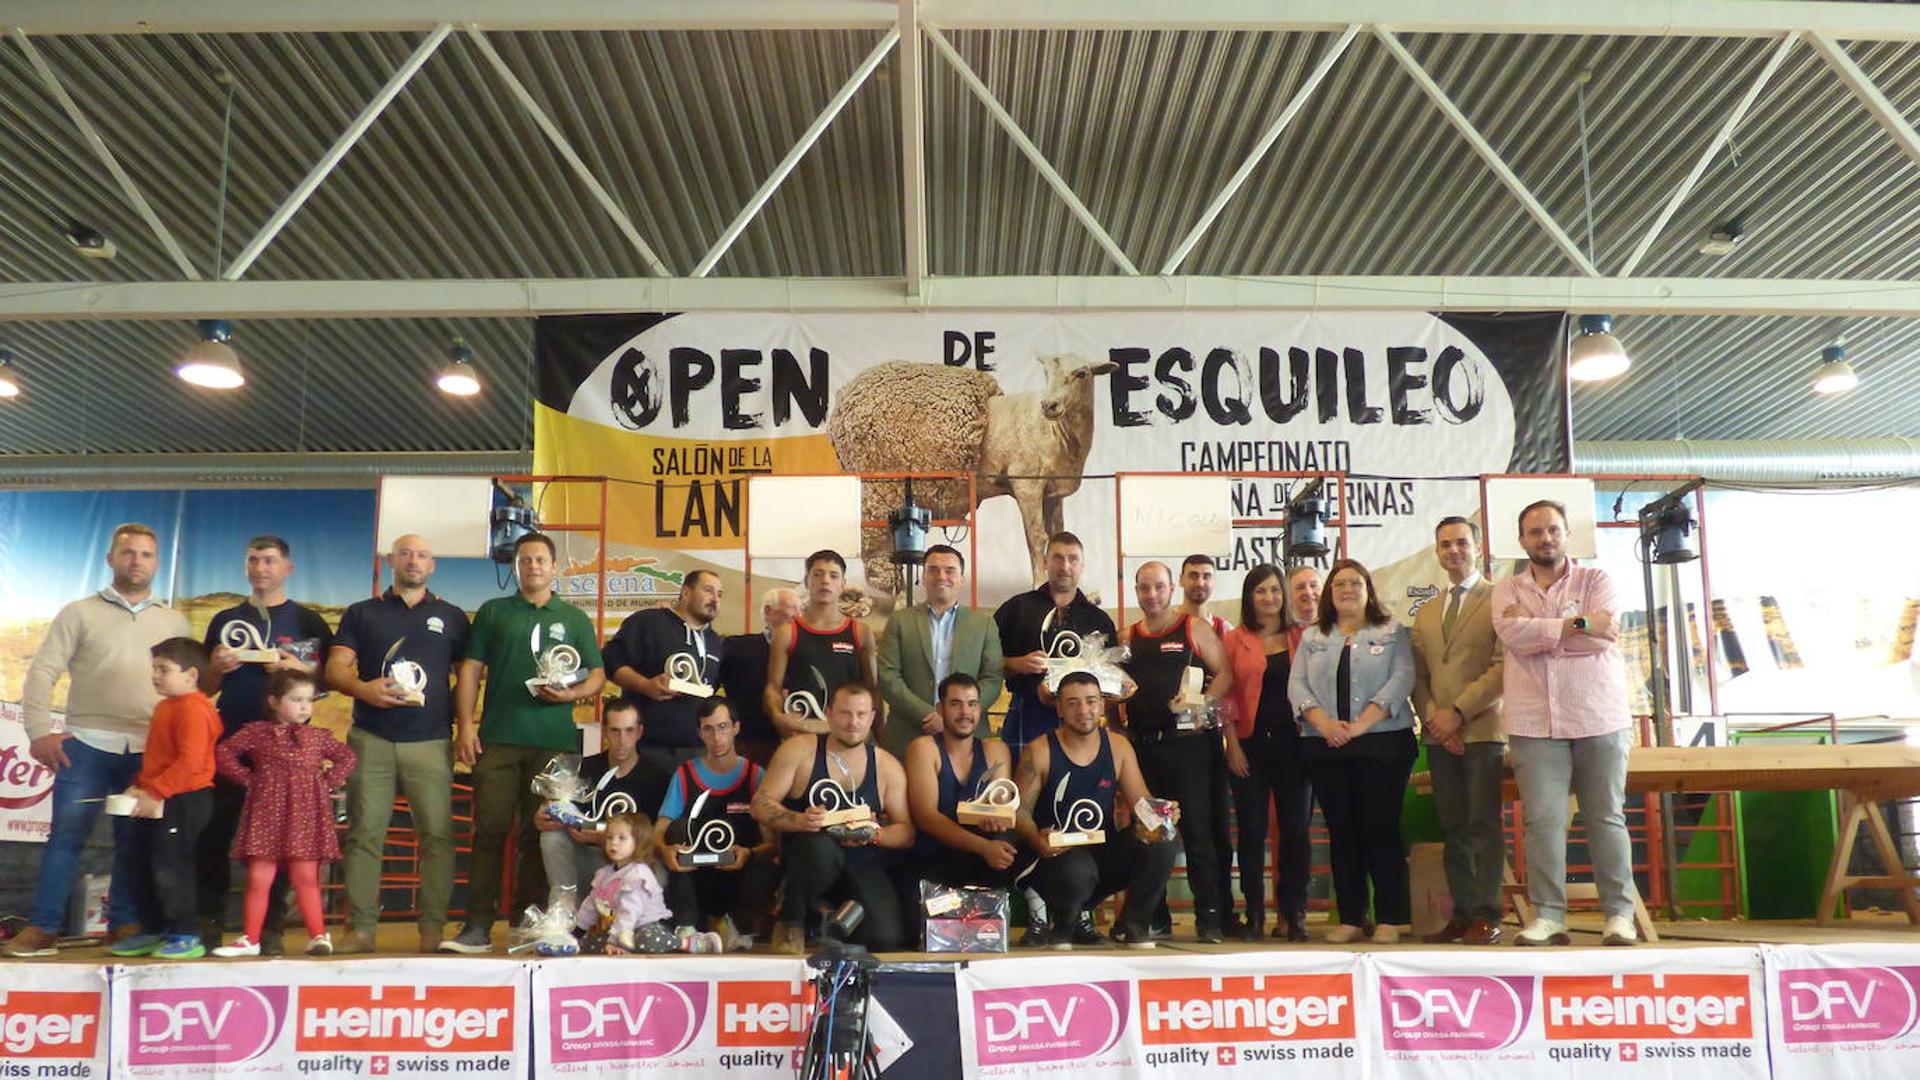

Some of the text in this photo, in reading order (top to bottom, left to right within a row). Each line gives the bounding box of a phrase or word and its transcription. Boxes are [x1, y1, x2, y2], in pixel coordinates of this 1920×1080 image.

[611, 330, 1485, 430] OPEN DE ESQUILEO
[729, 447, 745, 467] DE
[753, 447, 772, 467] LA
[1181, 441, 1350, 472] CAMPEONATO
[655, 479, 746, 538] LAN
[1304, 482, 1414, 516] ERINAS
[570, 575, 655, 593] seena
[303, 986, 509, 1048] Heiniger
[560, 995, 655, 1040] DFV
[1146, 977, 1348, 1037] Heiniger
[1391, 988, 1482, 1028] DFV
[1550, 975, 1745, 1036] Heiniger
[1789, 979, 1878, 1022] DFV
[139, 1000, 235, 1042] DFV
[984, 997, 1078, 1042] DFV
[1393, 1030, 1422, 1040] Group
[562, 1041, 592, 1051] Group
[719, 1050, 784, 1069] quality
[1146, 1043, 1354, 1068] quality swiss made
[1549, 1042, 1752, 1062] quality swiss made
[38, 1061, 90, 1078] made
[297, 1055, 510, 1074] quality swiss made
